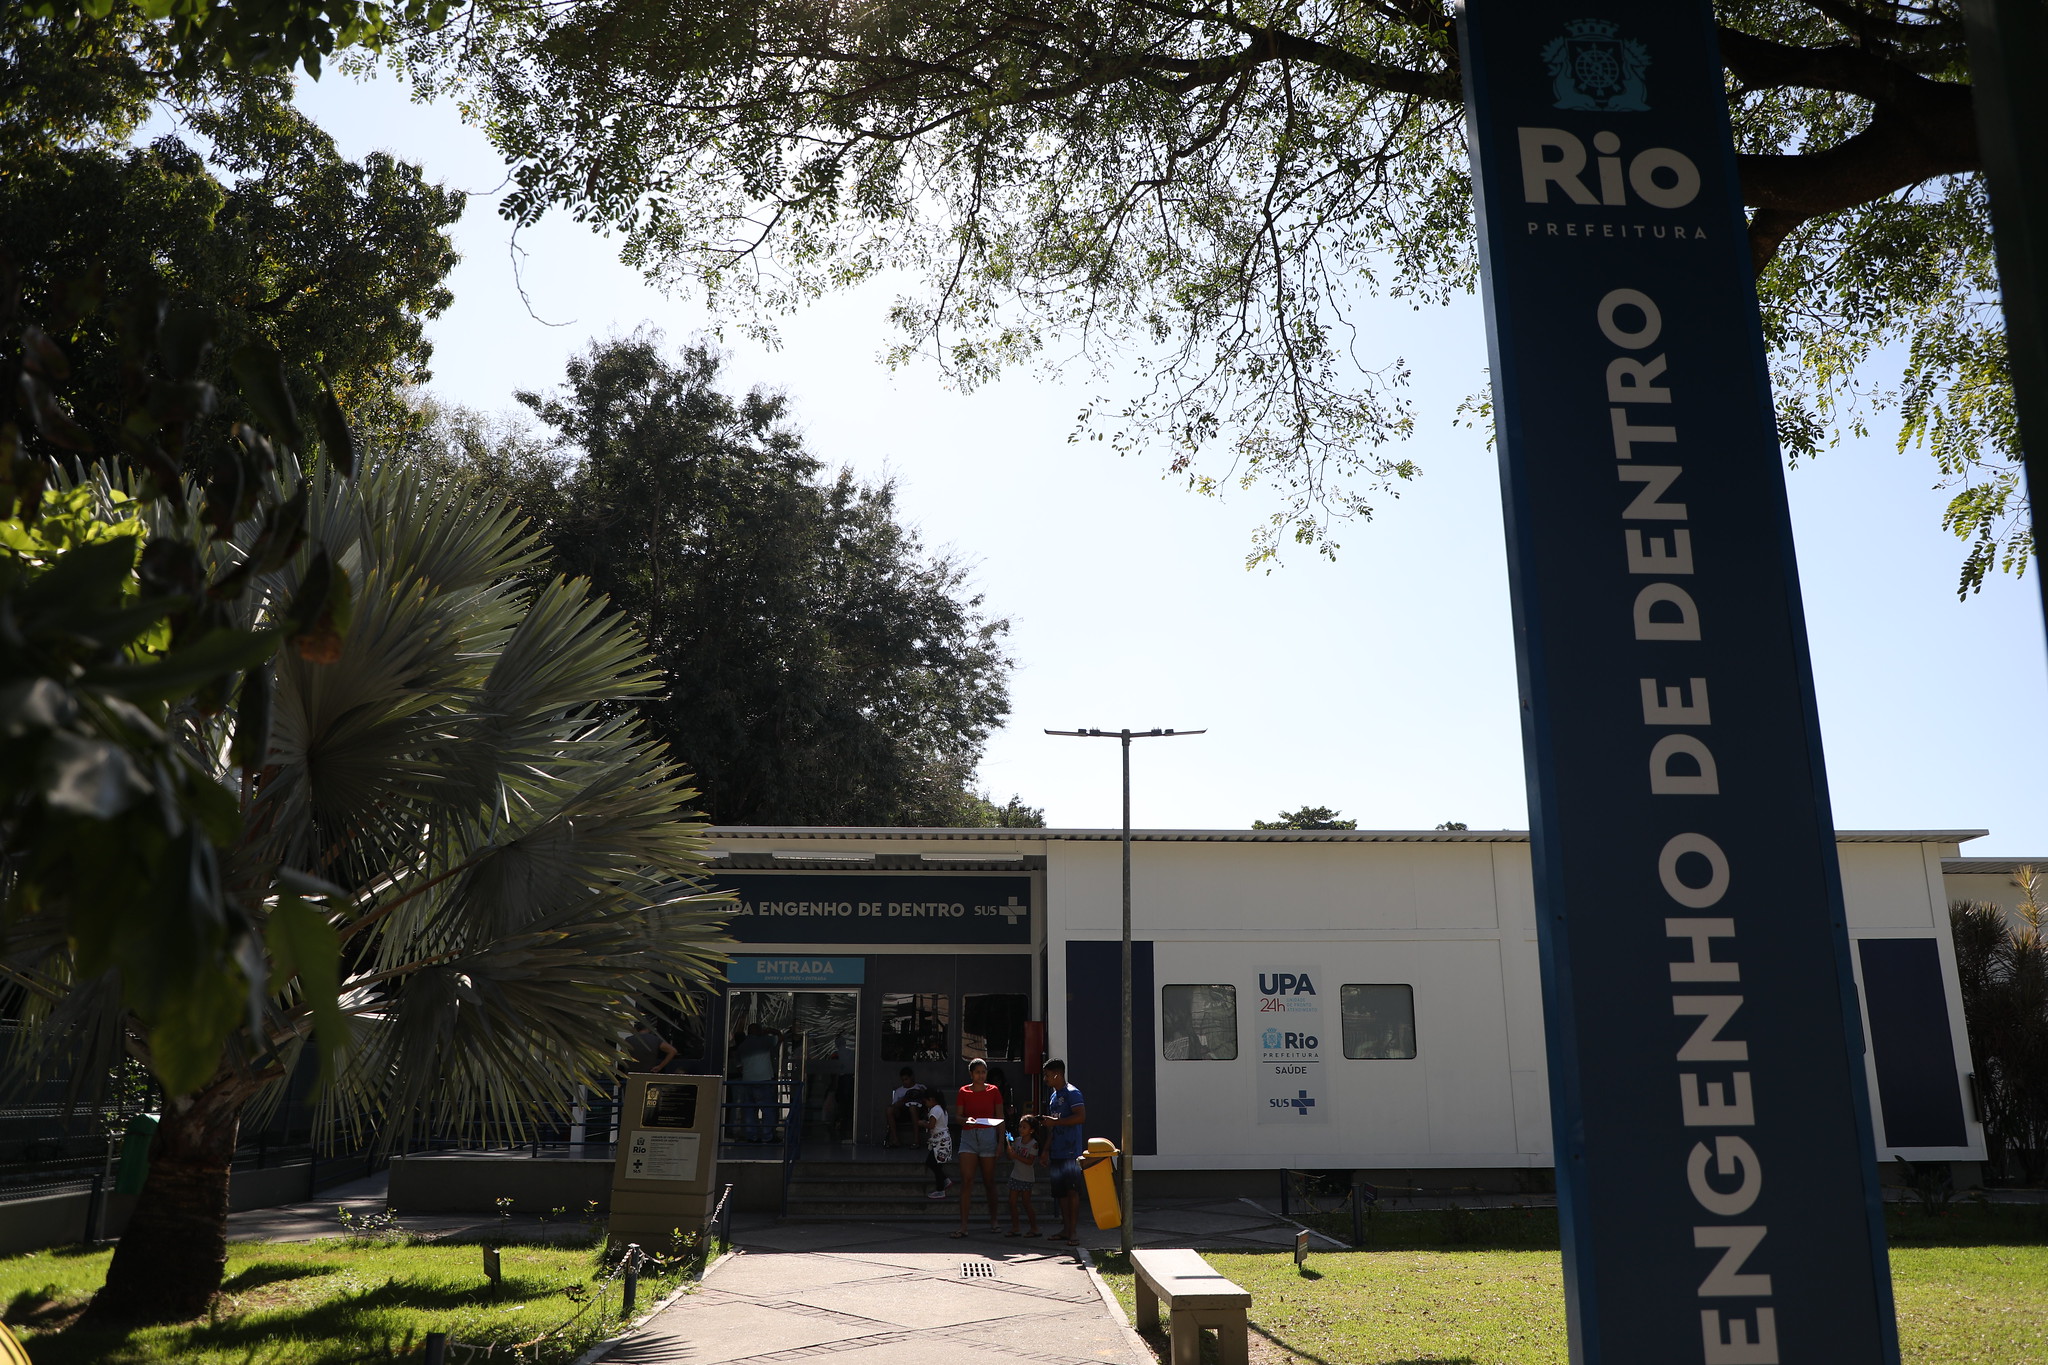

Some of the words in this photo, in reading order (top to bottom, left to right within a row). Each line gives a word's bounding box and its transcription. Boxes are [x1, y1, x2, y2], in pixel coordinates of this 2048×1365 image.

[1517, 127, 1701, 209] Rio
[1528, 222, 1707, 240] PREFEITURA
[1597, 288, 1702, 641] DENTRO
[1640, 677, 1720, 795] DE
[758, 902, 852, 917] ENGENHO
[858, 902, 882, 917] DE
[888, 903, 965, 917] DENTRO
[974, 905, 997, 916] SUS
[757, 960, 834, 974] ENTRADA
[1259, 973, 1316, 995] UPA
[1260, 998, 1285, 1012] 24h
[1285, 1032, 1318, 1049] Rio
[1275, 1064, 1307, 1074] SAÚDE
[1270, 1099, 1289, 1107] SUS
[1658, 832, 1780, 1365] ENGENHO
[633, 1146, 646, 1154] Rio
